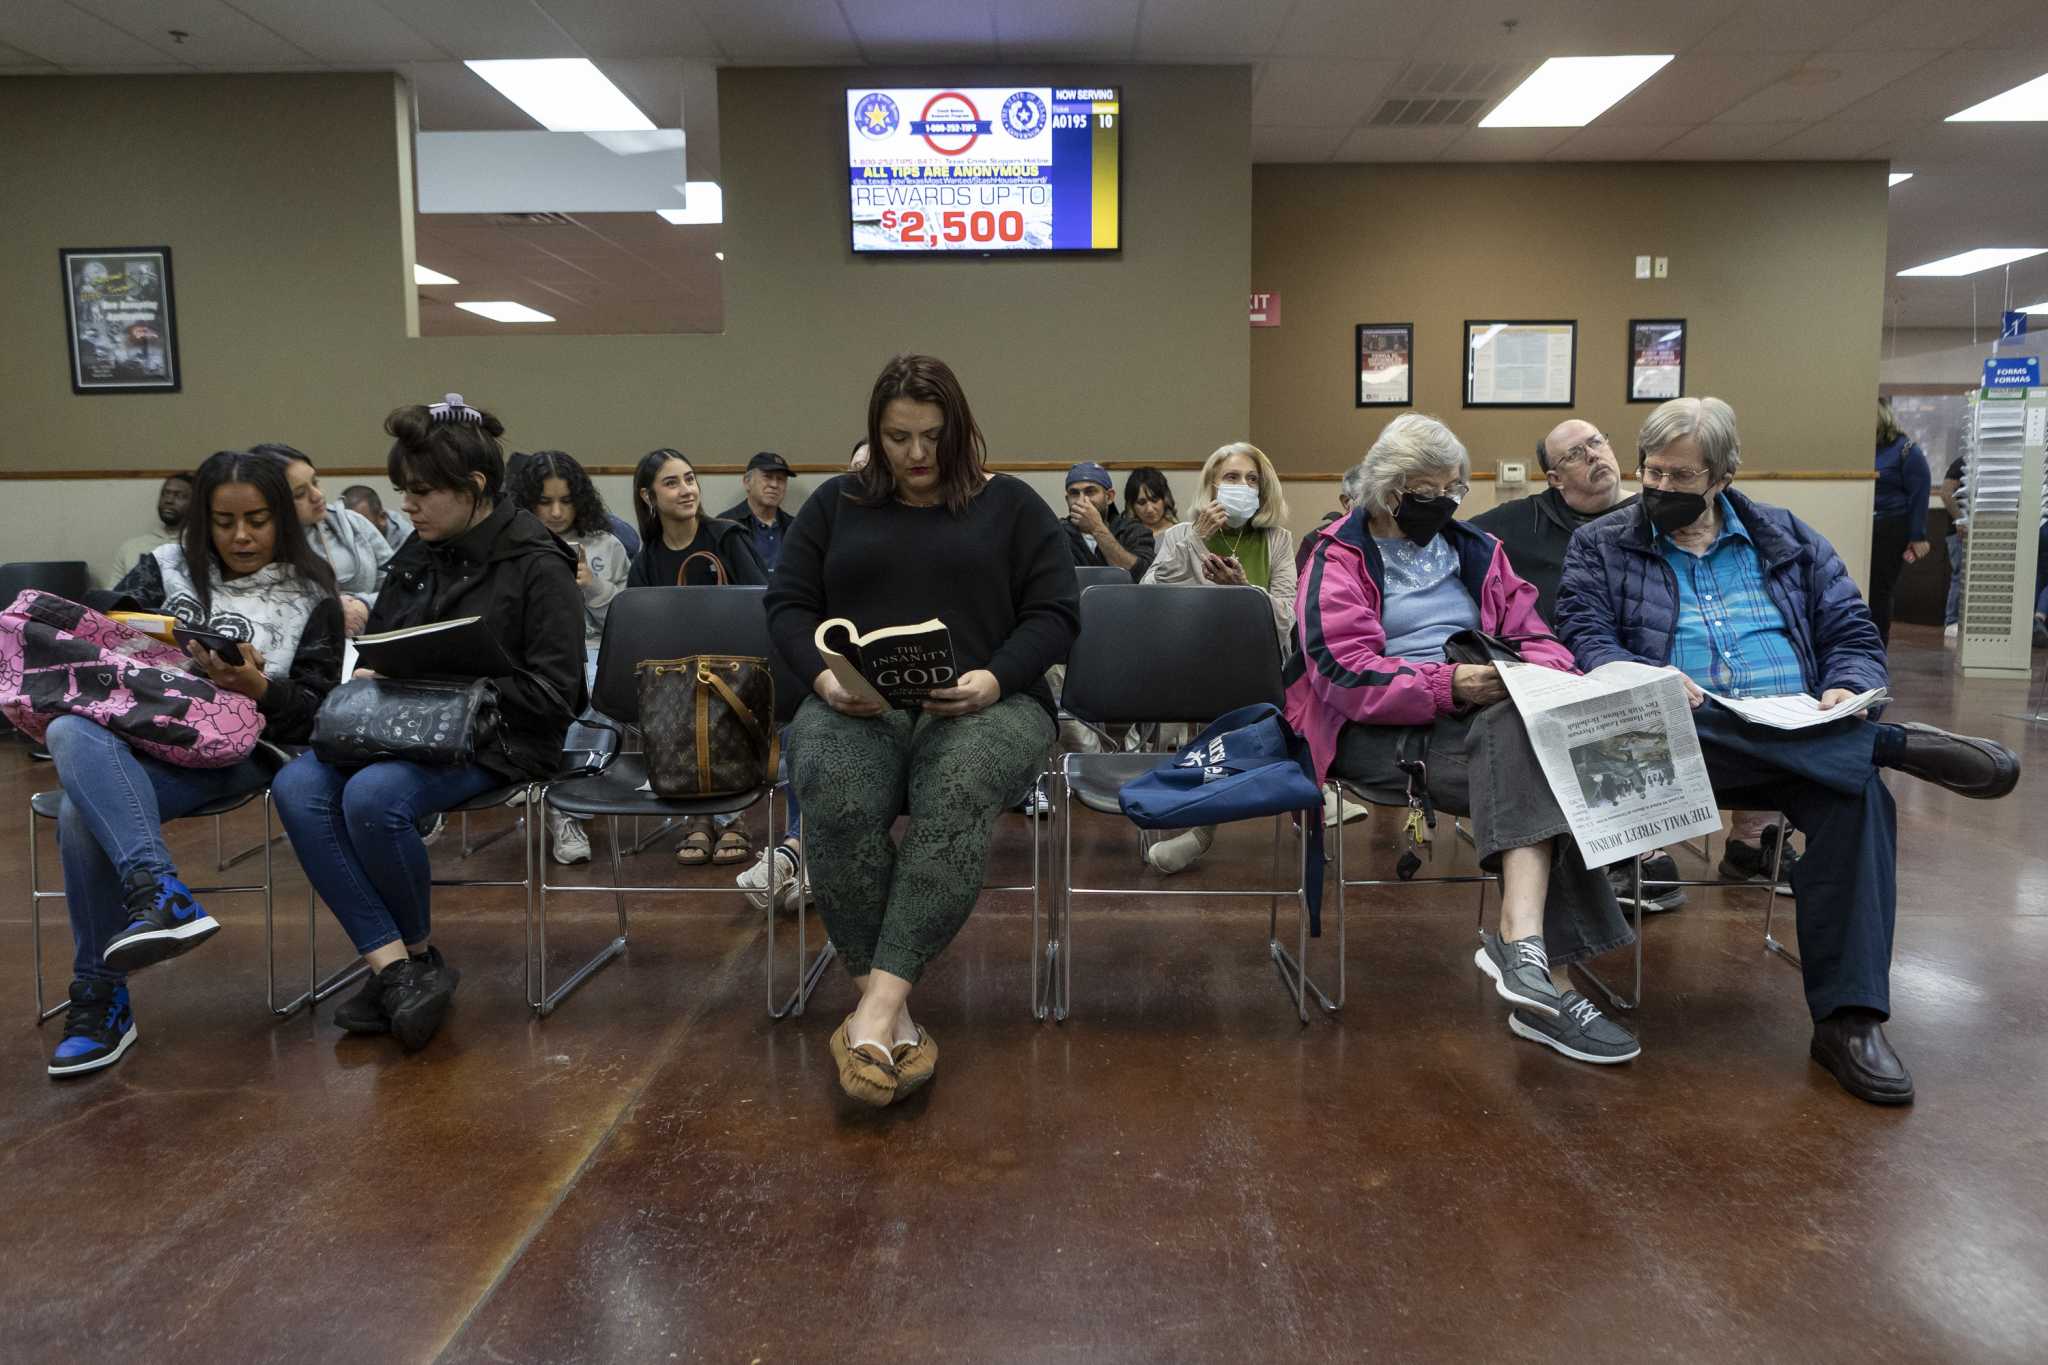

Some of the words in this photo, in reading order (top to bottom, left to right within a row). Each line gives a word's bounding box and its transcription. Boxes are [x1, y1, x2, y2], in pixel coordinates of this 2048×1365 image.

[1055, 89, 1077, 100] NOW
[1077, 89, 1114, 100] SERVING
[1052, 114, 1088, 128] A0195
[1099, 114, 1113, 128] 10
[863, 166, 889, 178] ALL
[892, 166, 920, 178] TIPS
[924, 165, 950, 178] ARE
[953, 165, 1040, 177] ANONYMOUS
[856, 186, 972, 206] REWARDS
[980, 186, 1010, 206] UP
[1017, 186, 1046, 205] TO
[881, 209, 1024, 248] $2,500
[1994, 375, 2031, 384] FORMAS
[1996, 367, 2028, 376] FORMS
[894, 645, 922, 654] THE
[872, 648, 948, 668] INSANITY
[877, 666, 954, 687] GOD
[1663, 813, 1690, 832] WALL
[1690, 806, 1713, 824] THE
[1624, 821, 1662, 843] STREET
